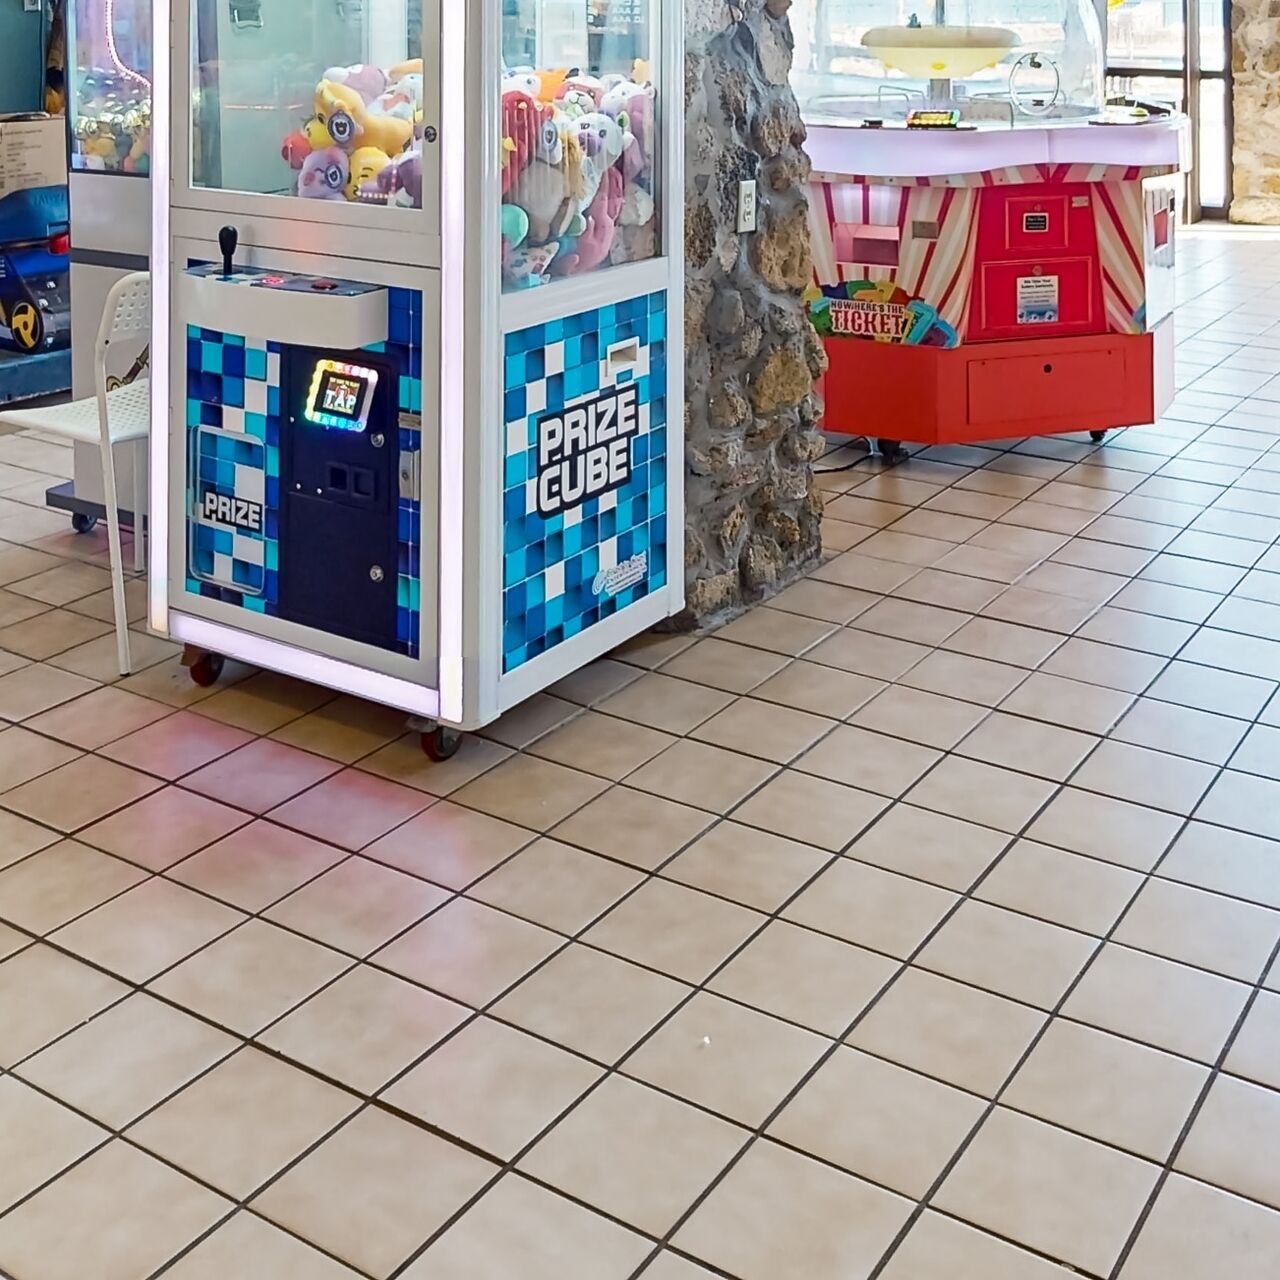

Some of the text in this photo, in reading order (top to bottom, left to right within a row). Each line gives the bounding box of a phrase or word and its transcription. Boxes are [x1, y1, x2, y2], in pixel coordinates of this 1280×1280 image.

[832, 309, 903, 336] TICKET
[887, 304, 904, 315] THE
[323, 389, 357, 410] TAP
[540, 389, 636, 467] PRIZE
[540, 437, 627, 512] CUBE
[205, 491, 260, 530] PRIZE
